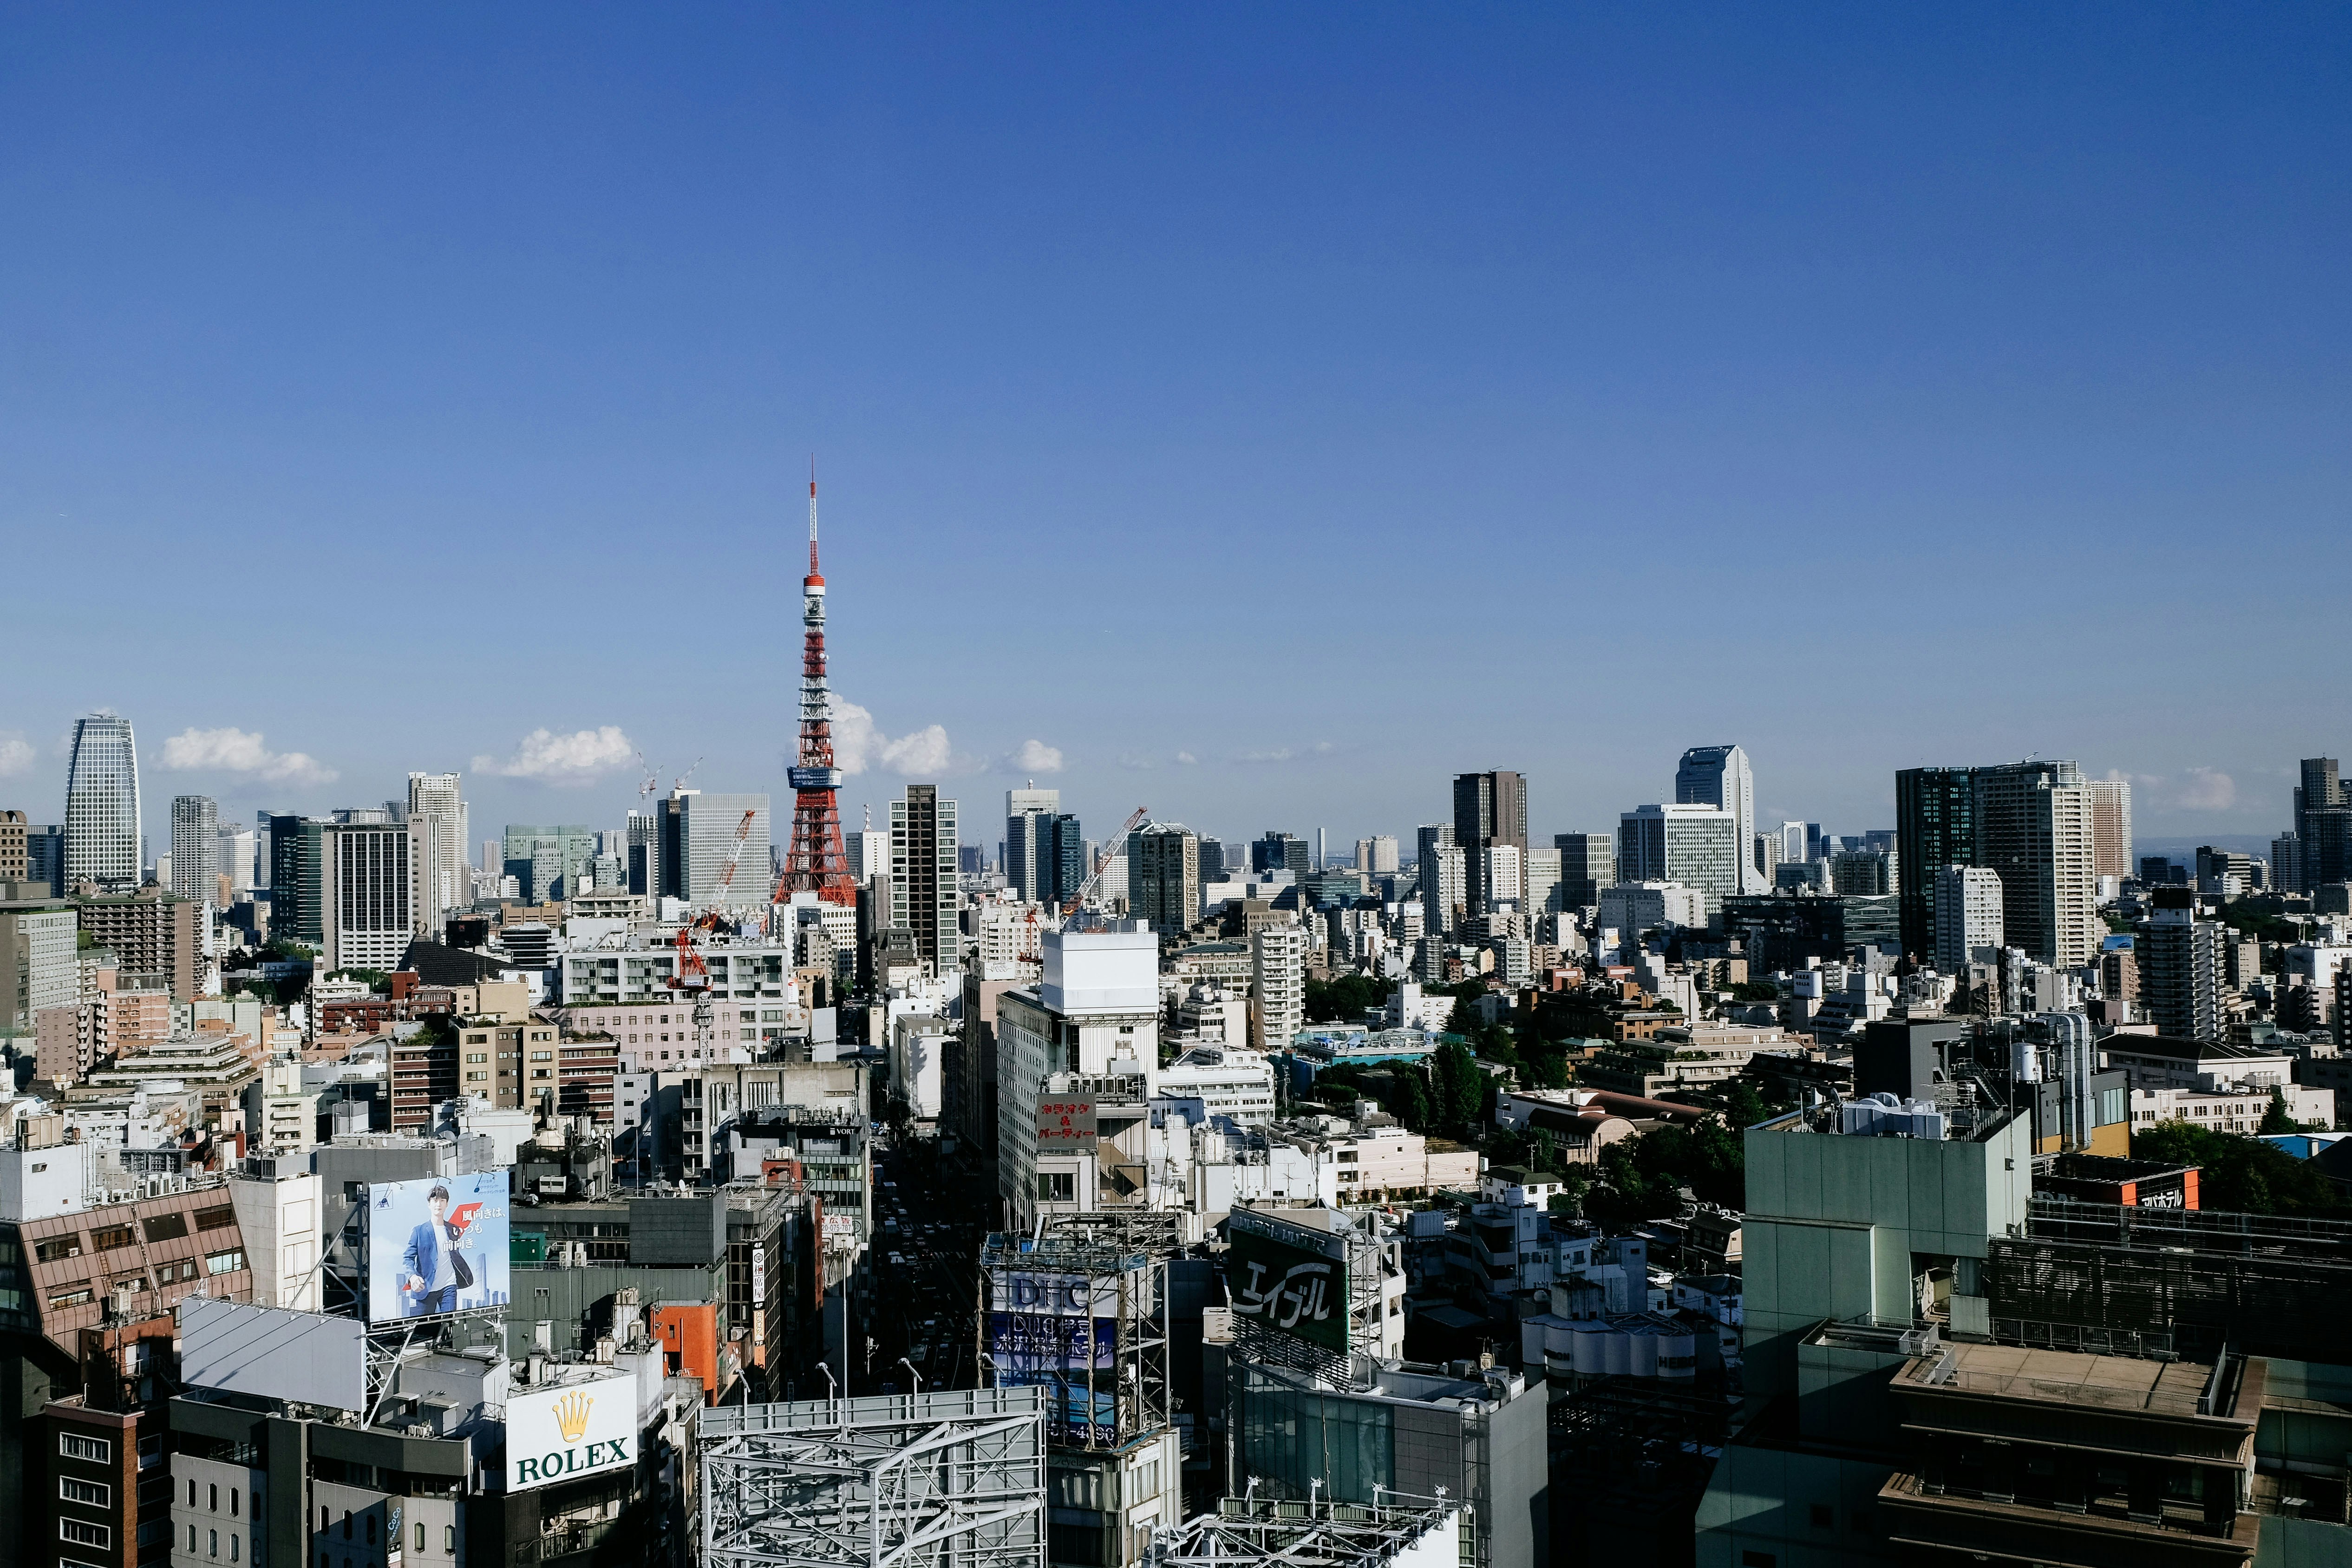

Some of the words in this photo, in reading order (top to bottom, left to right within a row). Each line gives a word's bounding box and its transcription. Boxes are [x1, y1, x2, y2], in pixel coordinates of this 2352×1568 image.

[1042, 1104, 1089, 1114] カラオケ
[1060, 1116, 1071, 1126] &
[2142, 1189, 2182, 1208] アパホテル
[462, 1207, 506, 1222] 風向きは、
[452, 1223, 483, 1236] いつも
[443, 1238, 477, 1252] 前向き。
[1015, 1278, 1091, 1307] DHC
[1232, 1261, 1331, 1328] エイブル
[516, 1437, 629, 1484] ROLEX
[388, 1507, 401, 1530] CoCo
